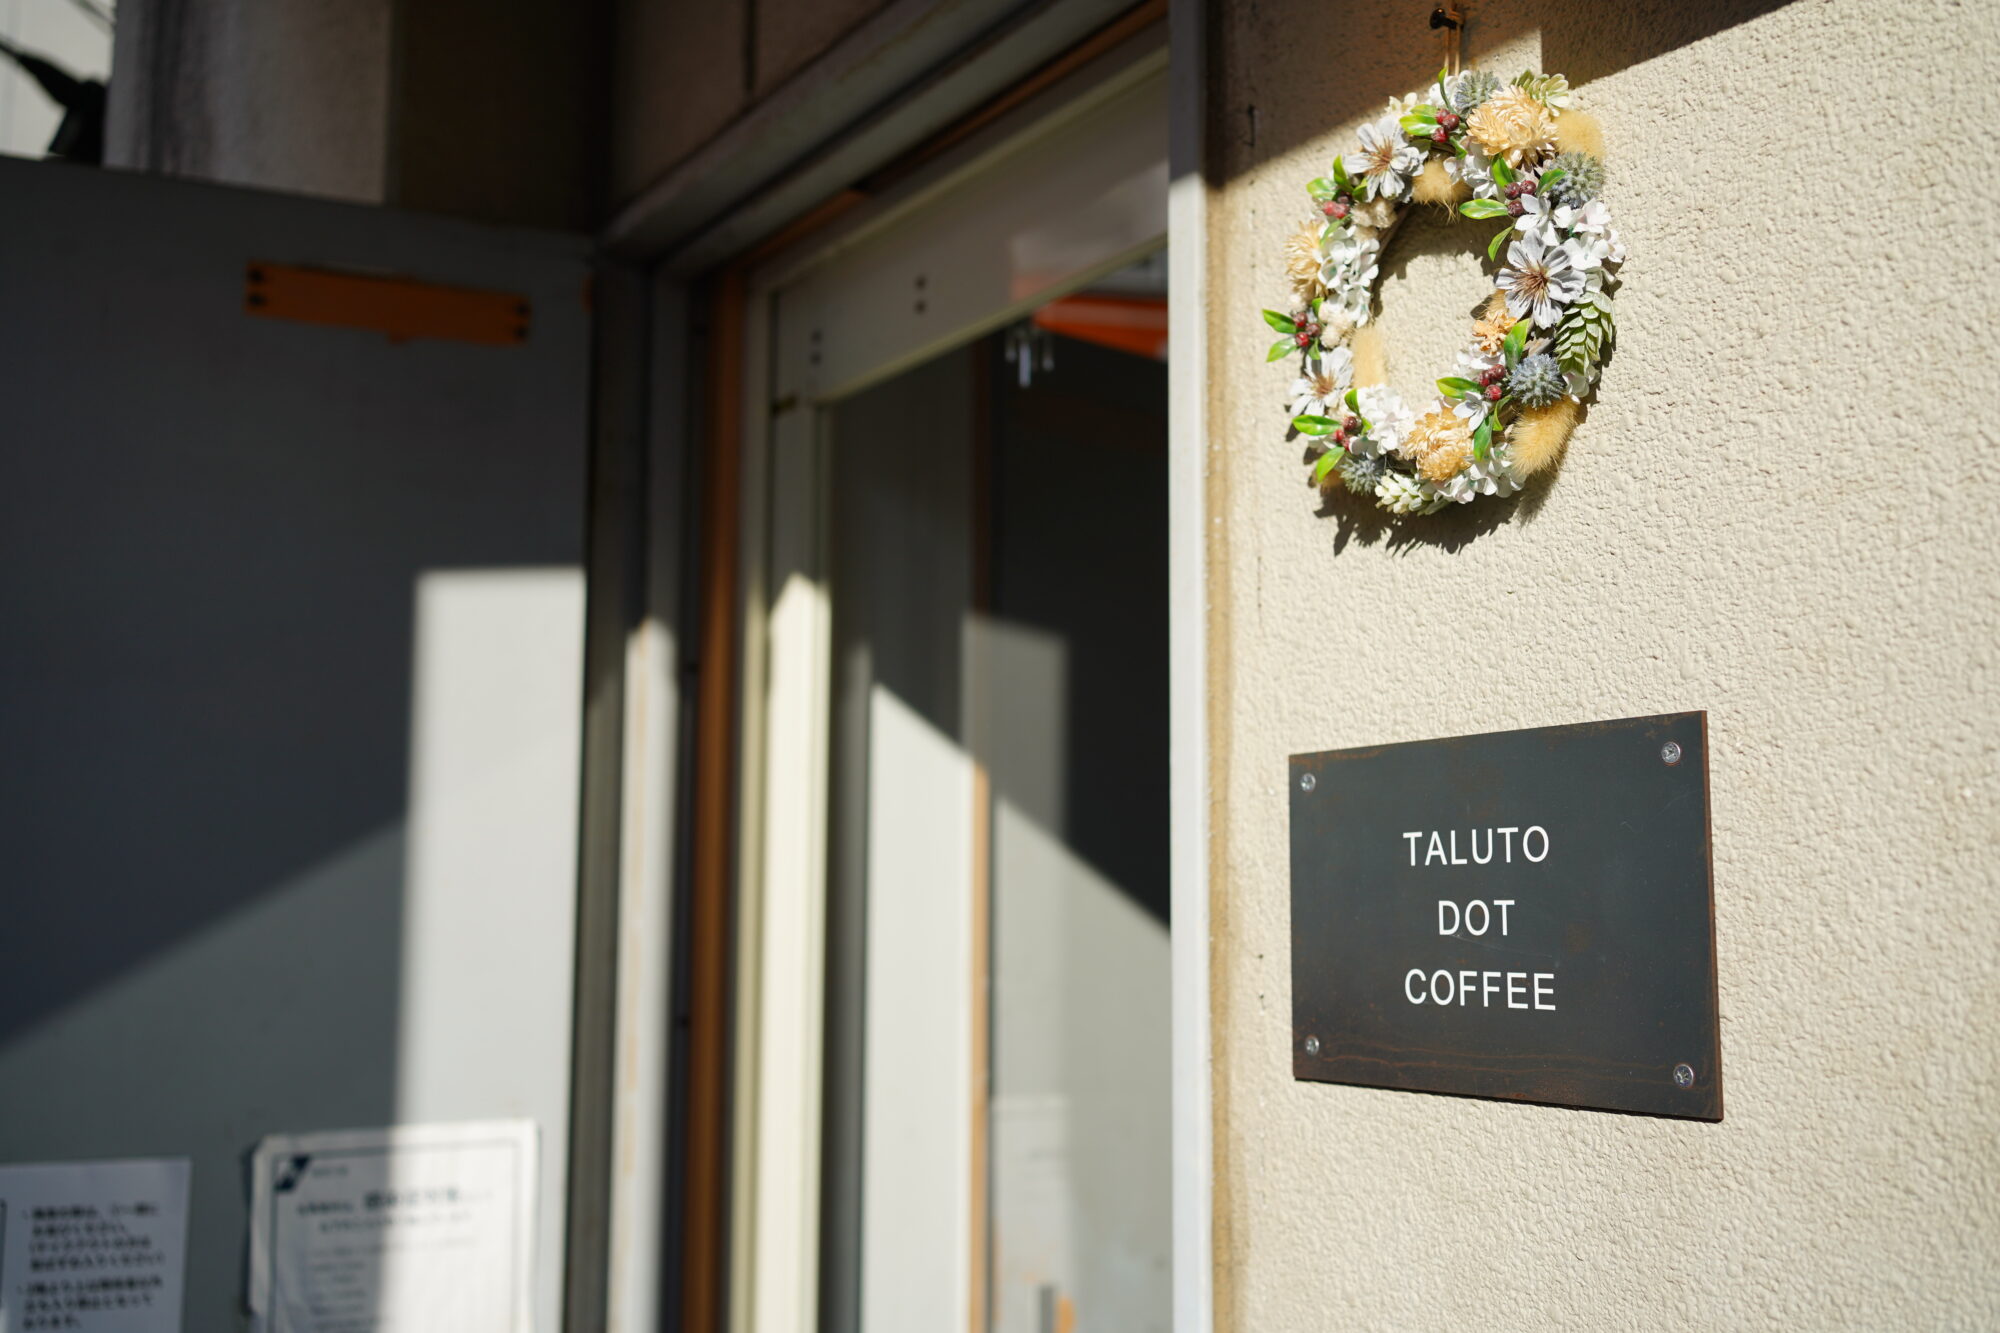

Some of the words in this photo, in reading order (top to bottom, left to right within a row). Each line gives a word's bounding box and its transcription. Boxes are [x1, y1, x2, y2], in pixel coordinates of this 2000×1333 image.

[1402, 825, 1550, 867] TALUTO
[1438, 899, 1516, 937] DOT
[1404, 968, 1556, 1011] COFFEE
